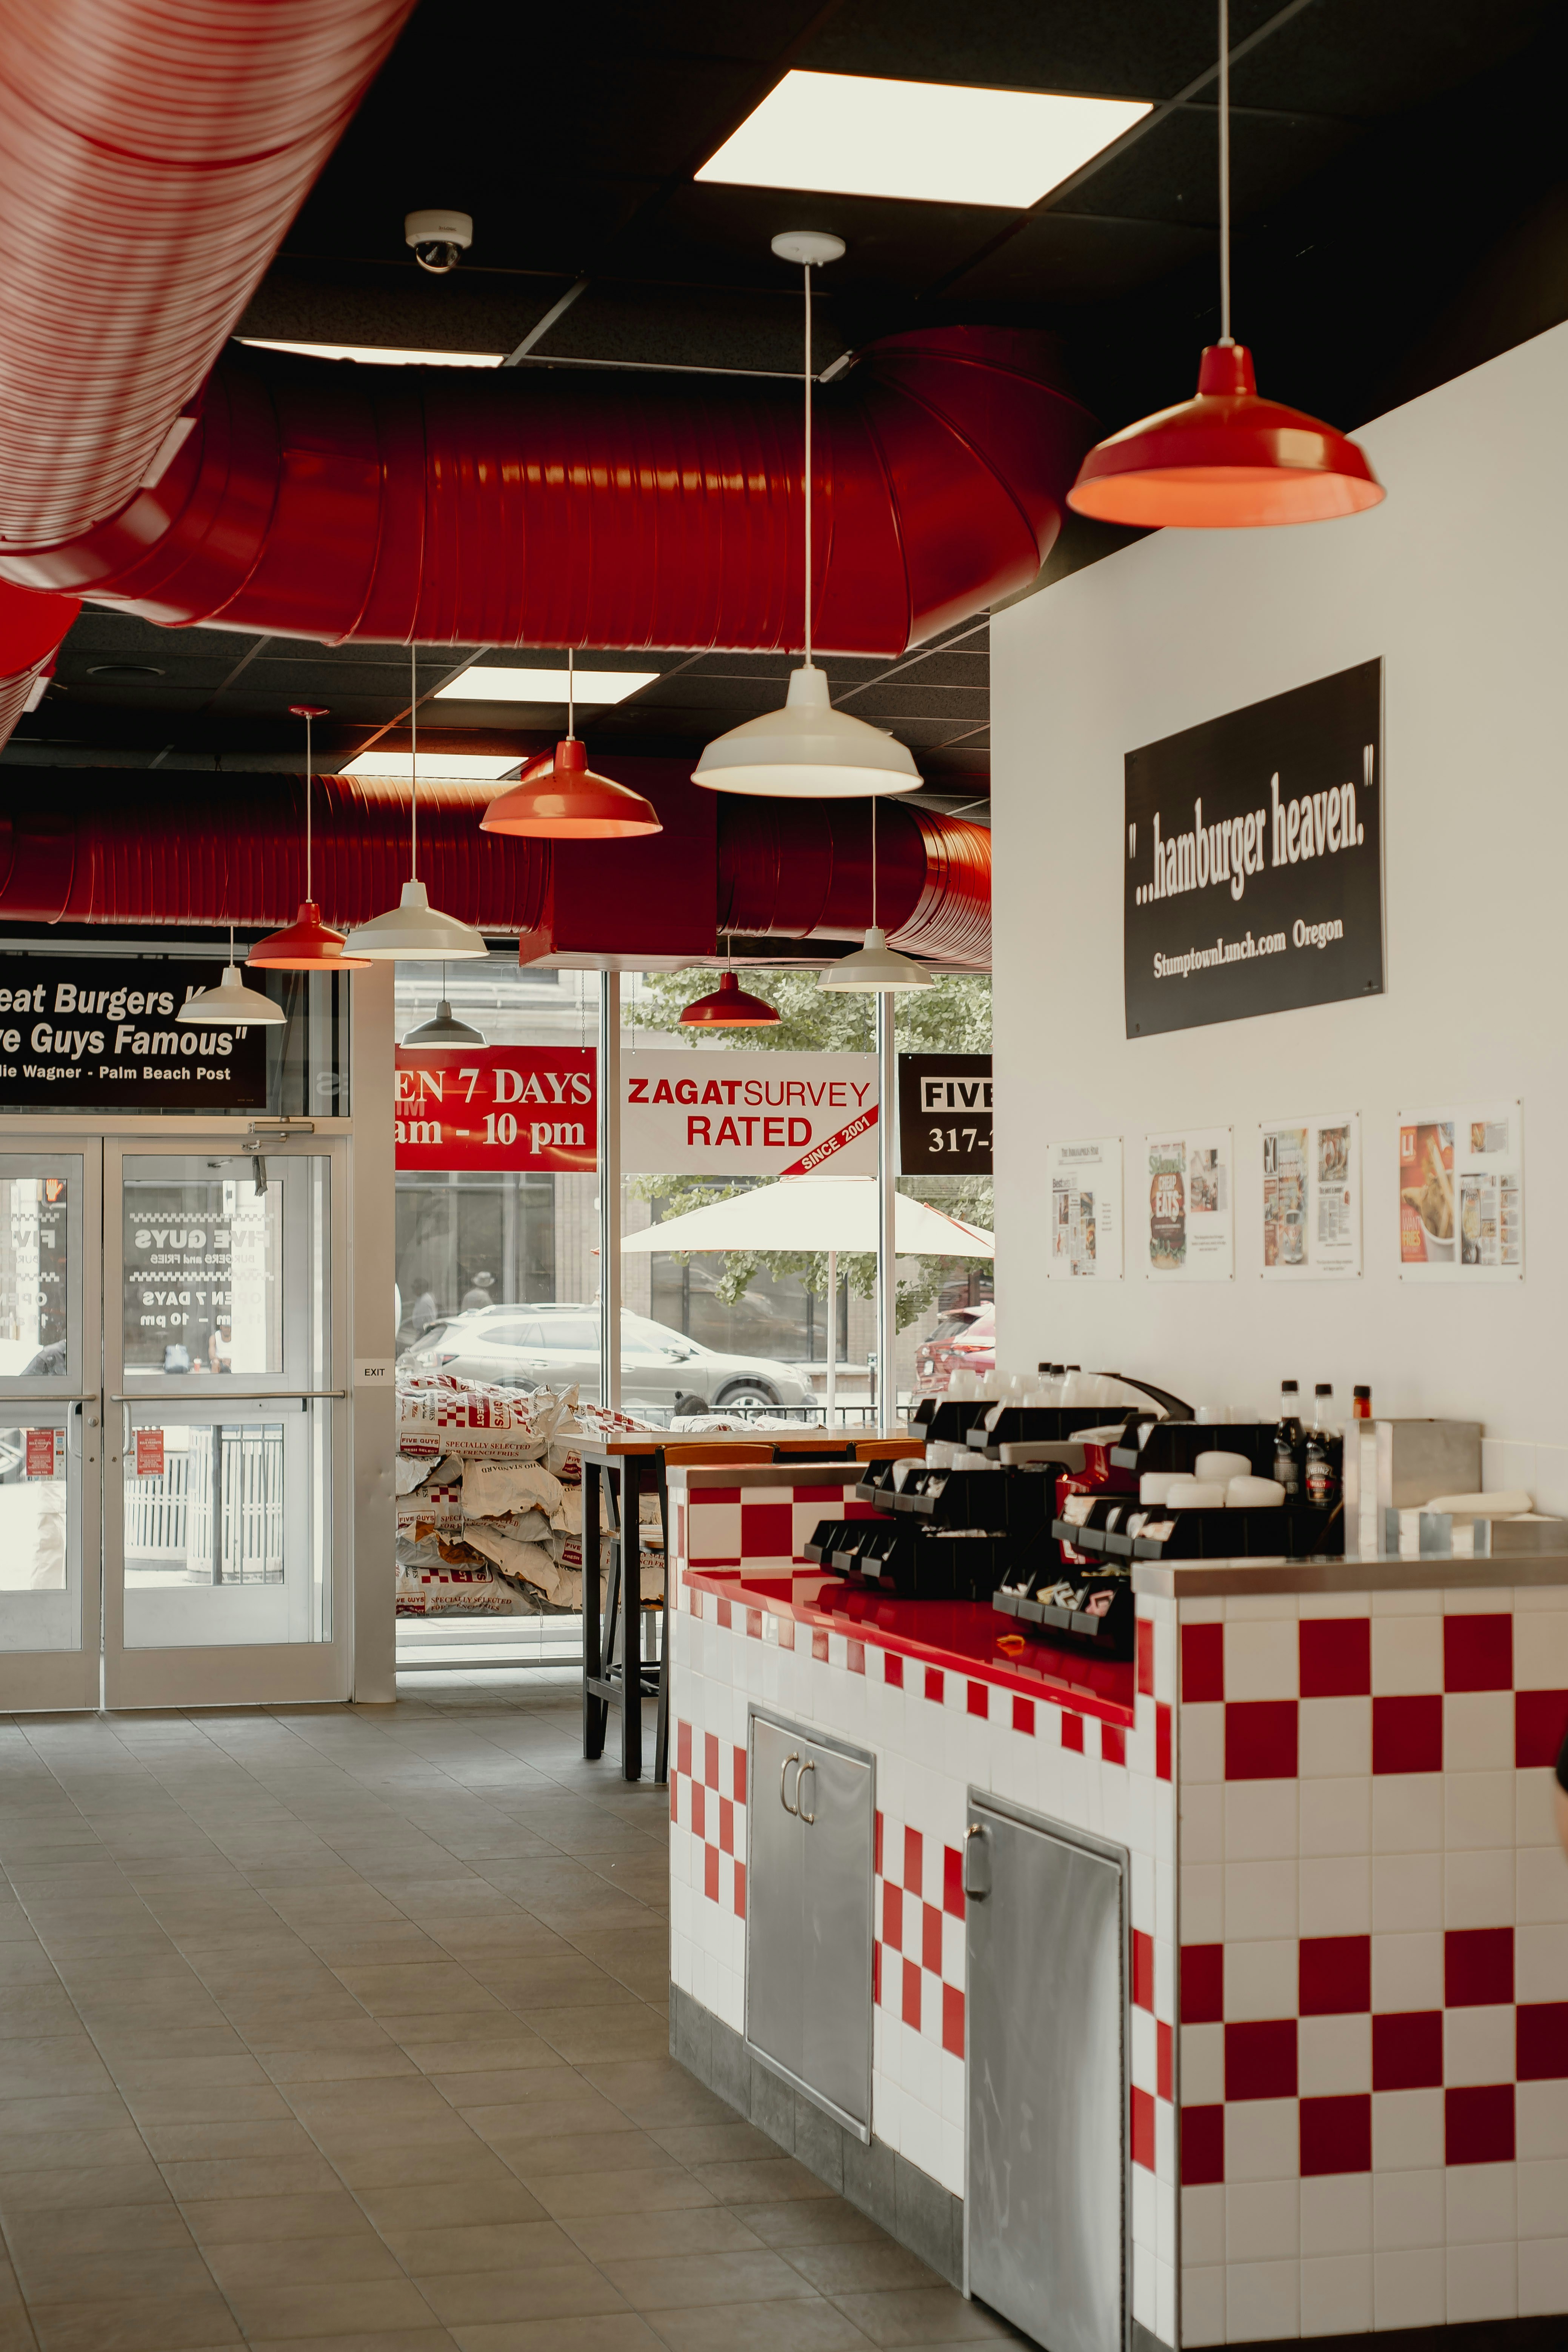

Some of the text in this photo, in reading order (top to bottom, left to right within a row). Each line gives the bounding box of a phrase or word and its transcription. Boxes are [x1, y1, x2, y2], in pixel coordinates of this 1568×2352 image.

[1154, 919, 1343, 978] StumptownLunch.com Oregon
[54, 984, 174, 1021] Burgers
[31, 1023, 104, 1060] Guys
[114, 1025, 247, 1055] Famous"
[23, 1065, 81, 1081] Wagner
[100, 1066, 137, 1079] Palm
[143, 1067, 190, 1079] Beach
[197, 1067, 230, 1080] Post
[395, 1068, 591, 1104] EN 7 DAYS
[395, 1120, 443, 1144] am
[483, 1113, 517, 1145] 10
[530, 1122, 586, 1154] pm
[687, 1116, 812, 1147] RATED
[802, 1116, 870, 1170] SINCE 2001
[929, 1128, 993, 1152] 317-
[1158, 1175, 1177, 1191] CHEAP
[1156, 1190, 1180, 1218] EATS
[1402, 1231, 1421, 1246] FRIES
[493, 1401, 504, 1427] GUYS
[482, 1464, 523, 1473] STANDARD
[1310, 1466, 1329, 1475] HEINZ
